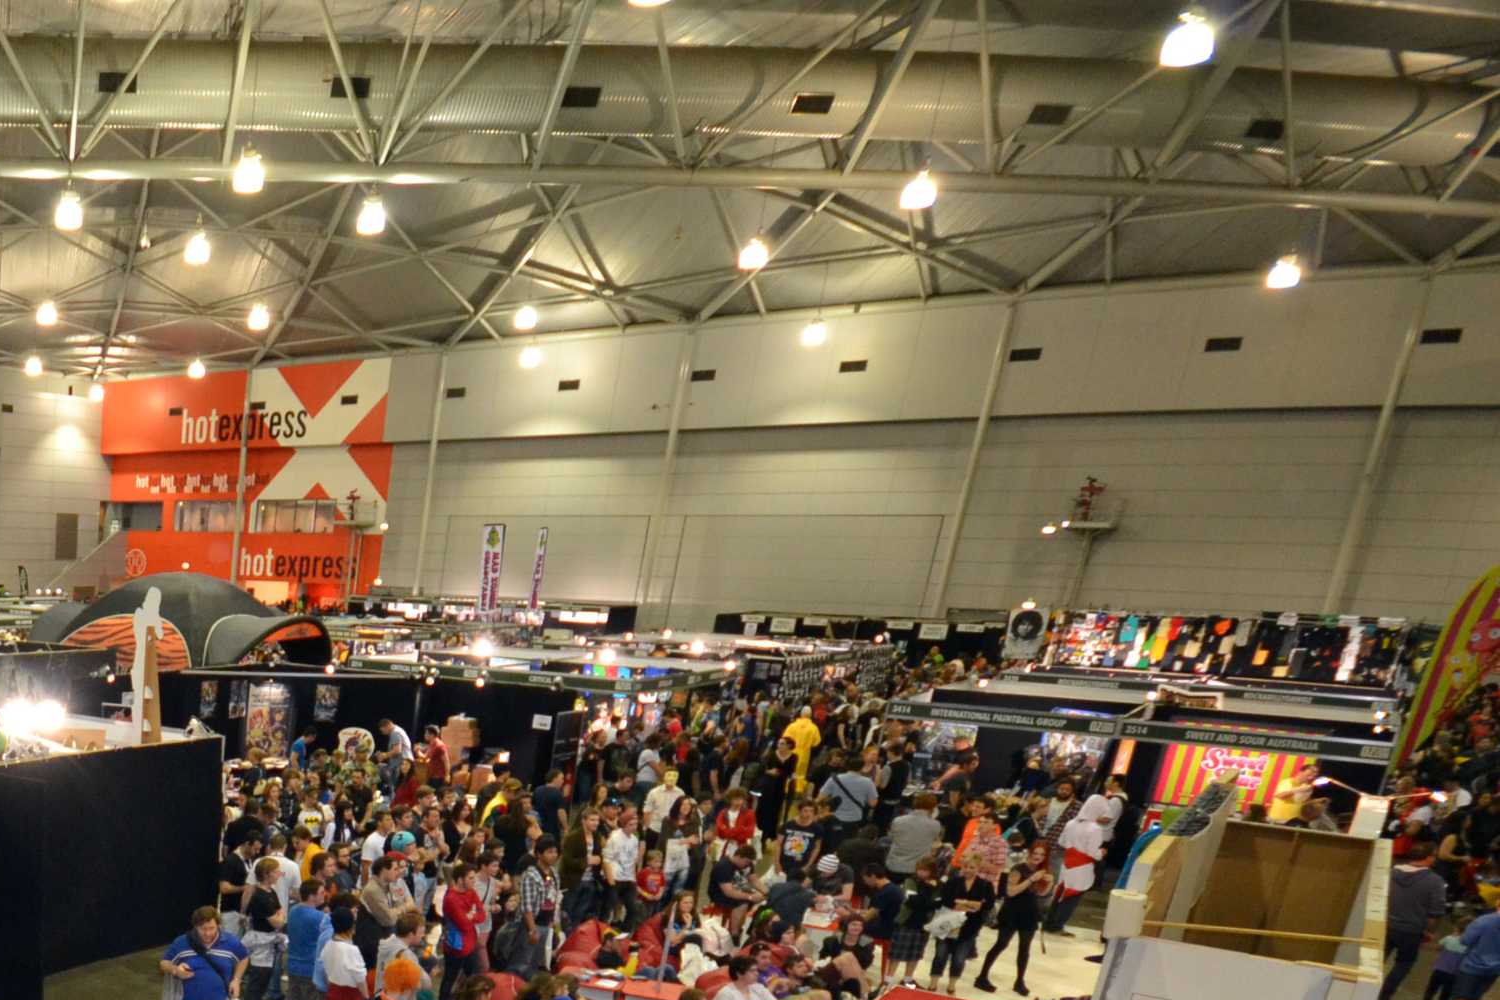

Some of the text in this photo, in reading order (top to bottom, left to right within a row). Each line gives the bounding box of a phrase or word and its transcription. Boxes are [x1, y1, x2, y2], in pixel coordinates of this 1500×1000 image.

[181, 408, 307, 445] hotexpress
[931, 708, 1067, 728] INTERNATIONAL PAINTBALL GROUP
[1185, 730, 1318, 750] SWEET AND SOUR AUSTRALIA
